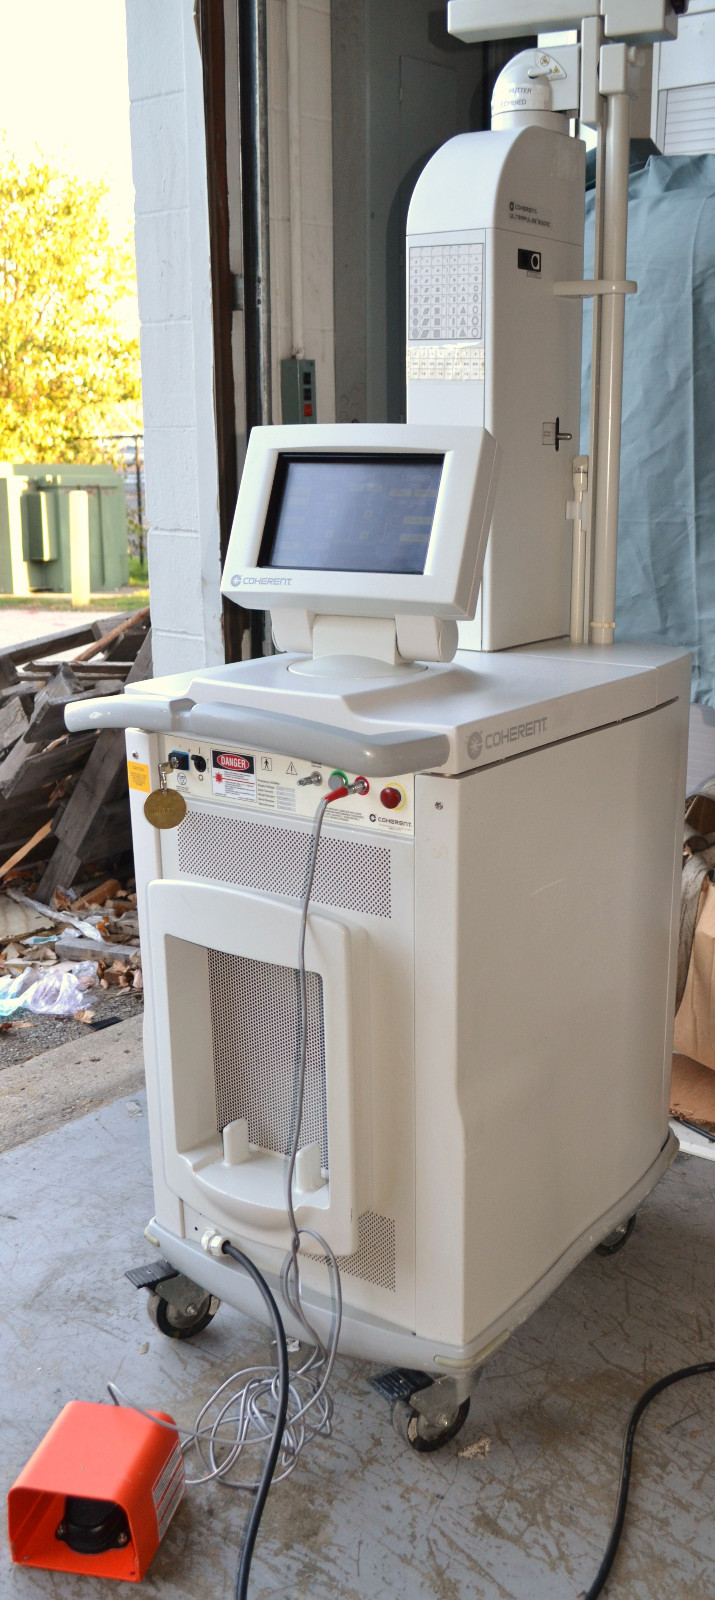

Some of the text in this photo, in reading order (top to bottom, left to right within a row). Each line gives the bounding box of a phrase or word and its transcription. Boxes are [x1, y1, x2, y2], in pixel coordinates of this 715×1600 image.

[242, 577, 293, 586] COHERENT
[485, 716, 548, 749] COHERENT
[220, 755, 246, 769] DANGER
[377, 816, 412, 828] COHERENT
